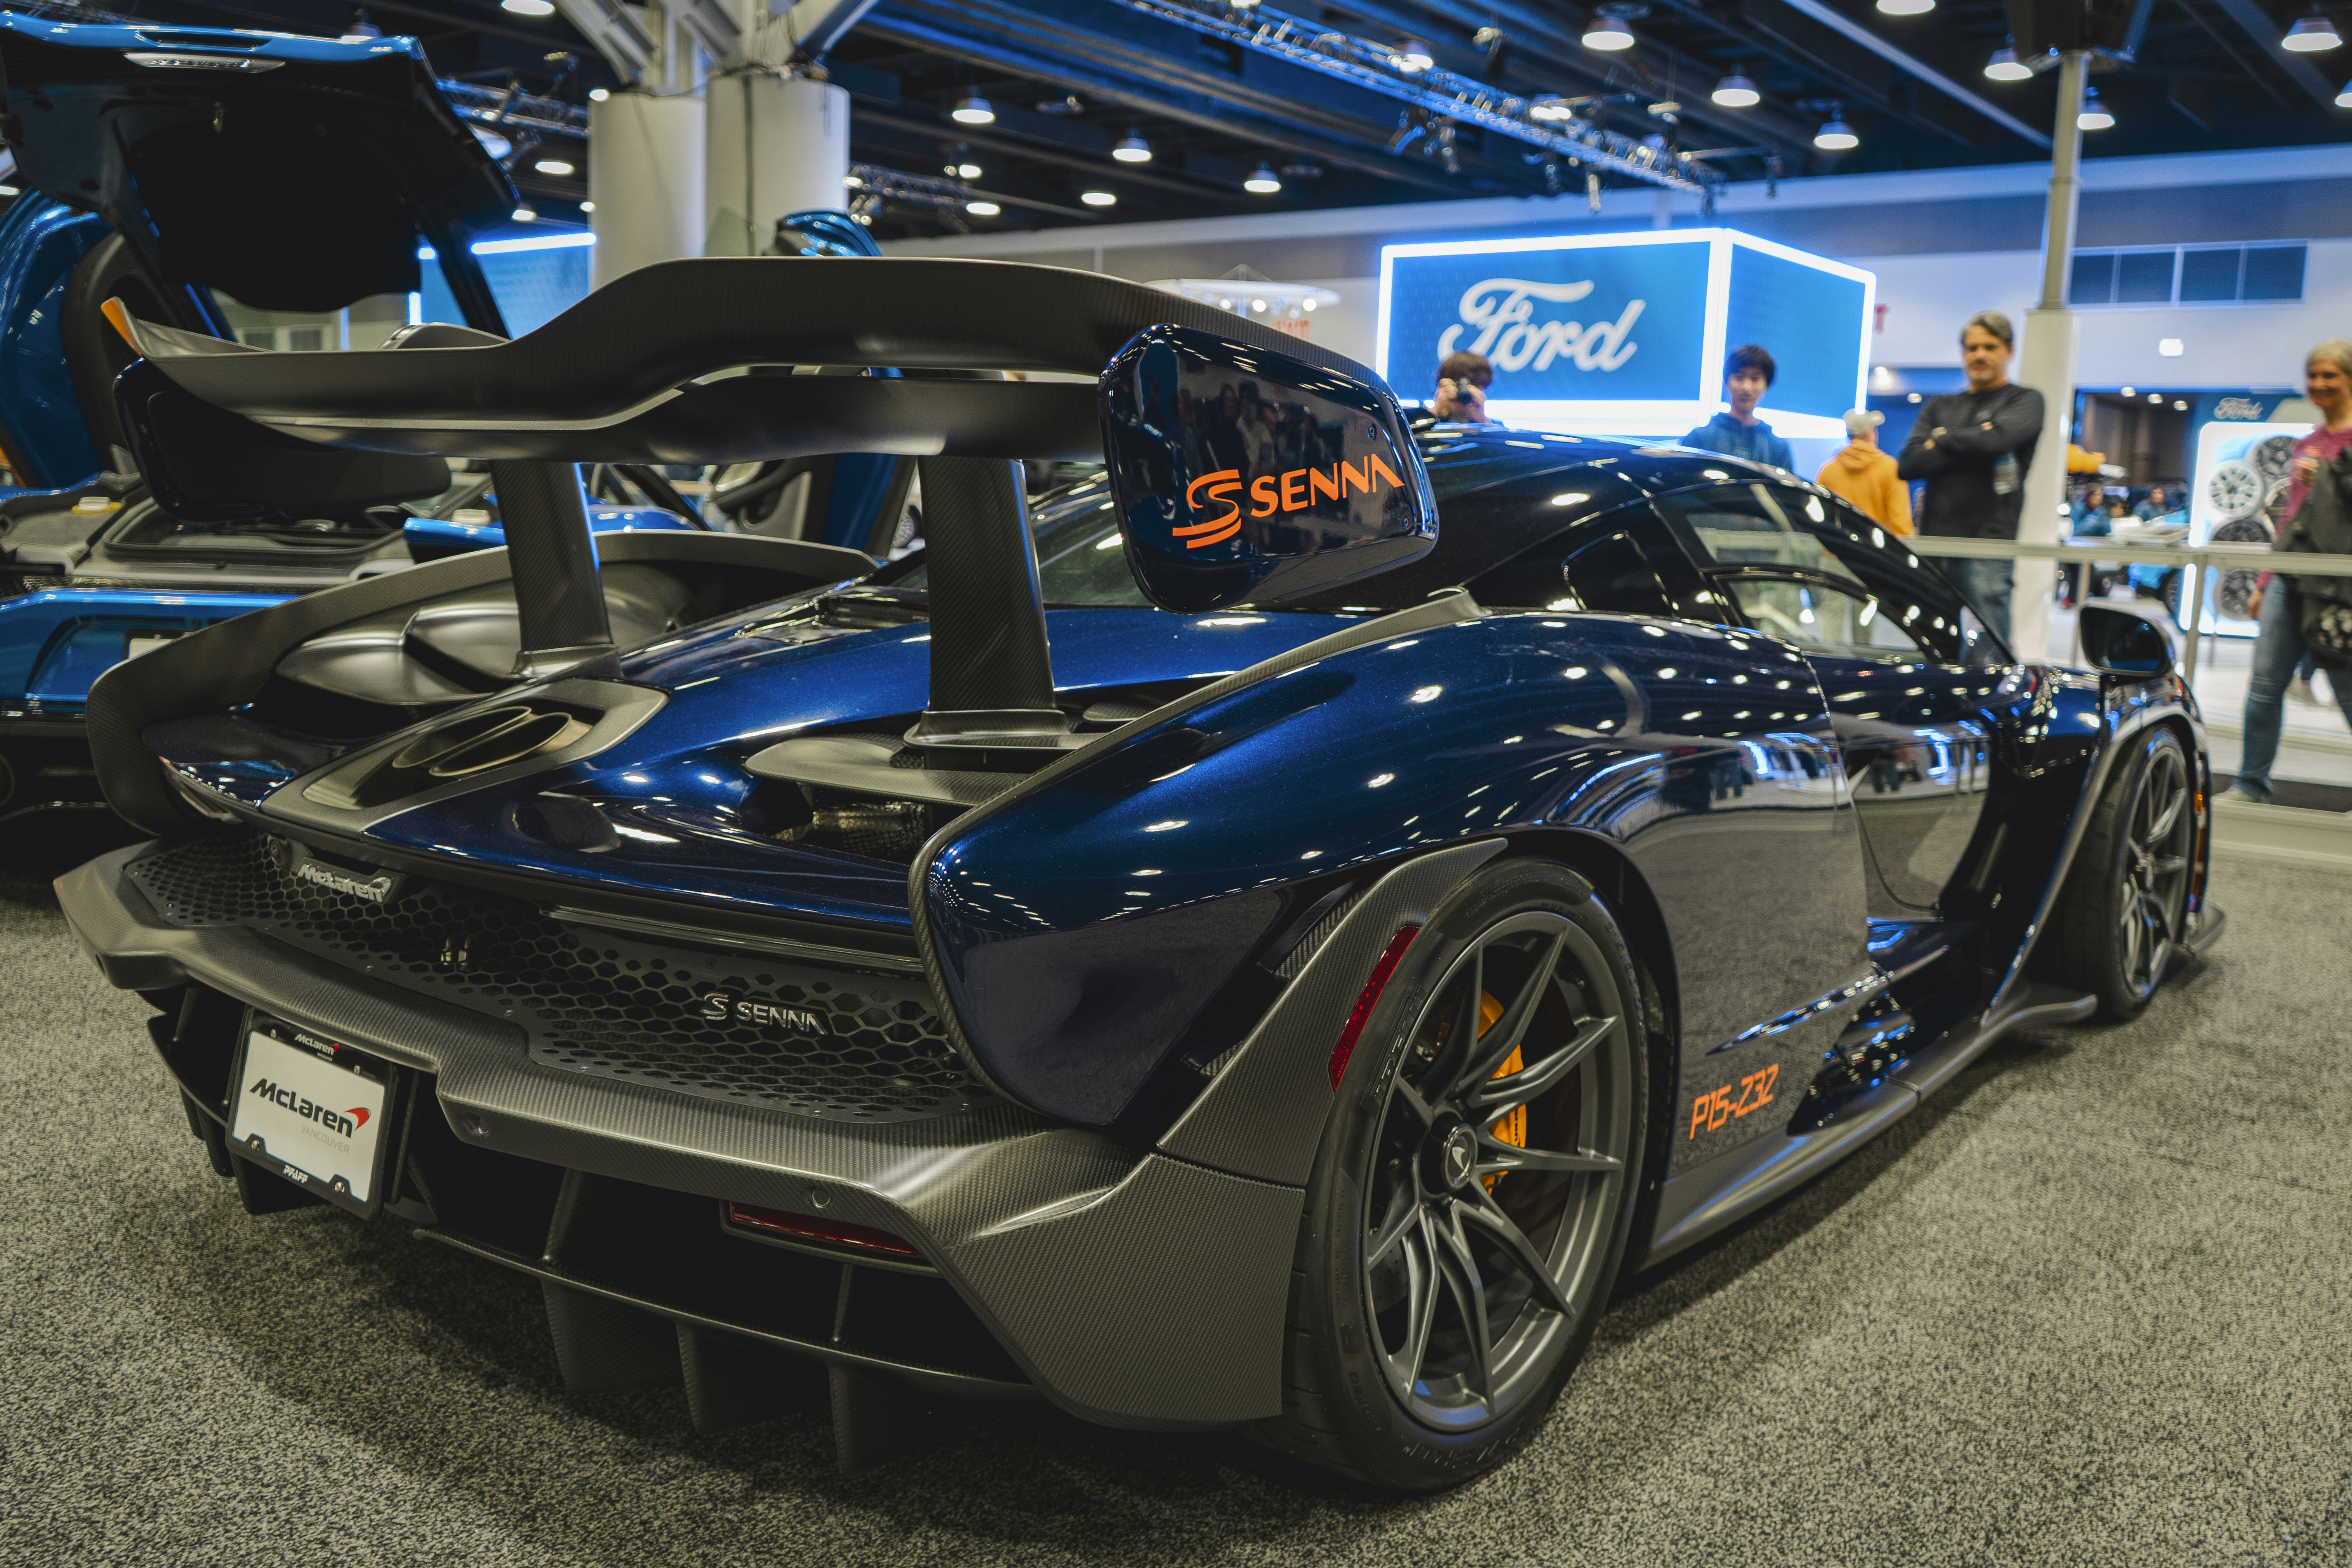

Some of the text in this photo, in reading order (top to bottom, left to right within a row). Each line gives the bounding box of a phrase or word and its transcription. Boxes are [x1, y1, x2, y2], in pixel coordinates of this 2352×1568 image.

[1437, 278, 1647, 372] Ford
[1251, 453, 1405, 518] SENNA
[298, 863, 383, 903] McLaren
[734, 1001, 827, 1035] SENNA
[294, 1034, 334, 1055] McLaren
[250, 1078, 352, 1139] McLaren
[1689, 1063, 1779, 1140] P15-232
[301, 1123, 350, 1154] VANCOUVER
[283, 1164, 308, 1183] PFAFF
